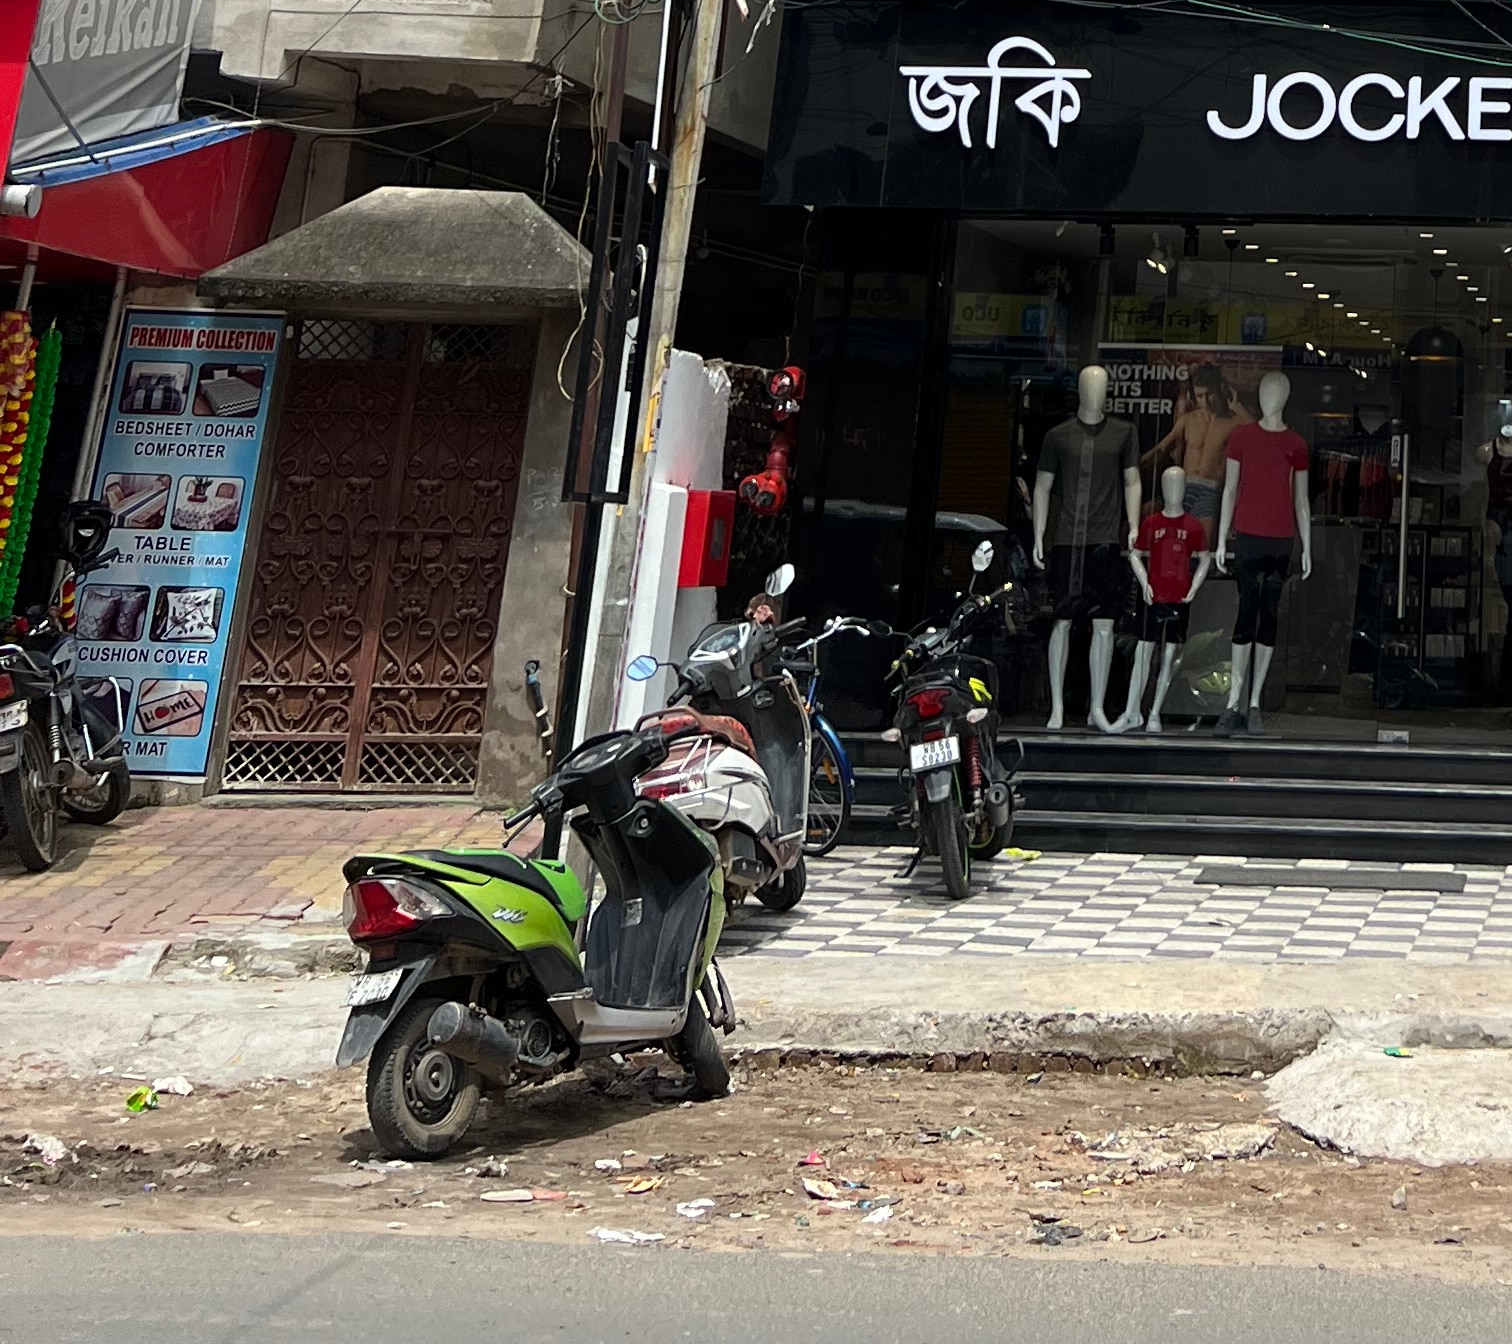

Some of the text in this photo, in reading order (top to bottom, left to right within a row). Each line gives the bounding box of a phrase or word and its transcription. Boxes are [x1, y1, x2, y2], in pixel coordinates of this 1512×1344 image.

[899, 36, 1093, 149] জকি
[128, 325, 277, 352] PREMIUM COLLECTION
[1104, 363, 1189, 381] NOTHING
[1103, 397, 1172, 414] BETTER
[115, 421, 193, 437] BEDSHEET
[203, 423, 256, 438] DOHAR
[134, 442, 226, 459] COMFORTER
[1154, 528, 1188, 541] SPTS
[134, 535, 191, 552] TABLE
[143, 554, 195, 566] RUNNER
[205, 555, 230, 567] MAT
[77, 646, 209, 665] CUSHION COVER
[135, 741, 168, 757] MAT
